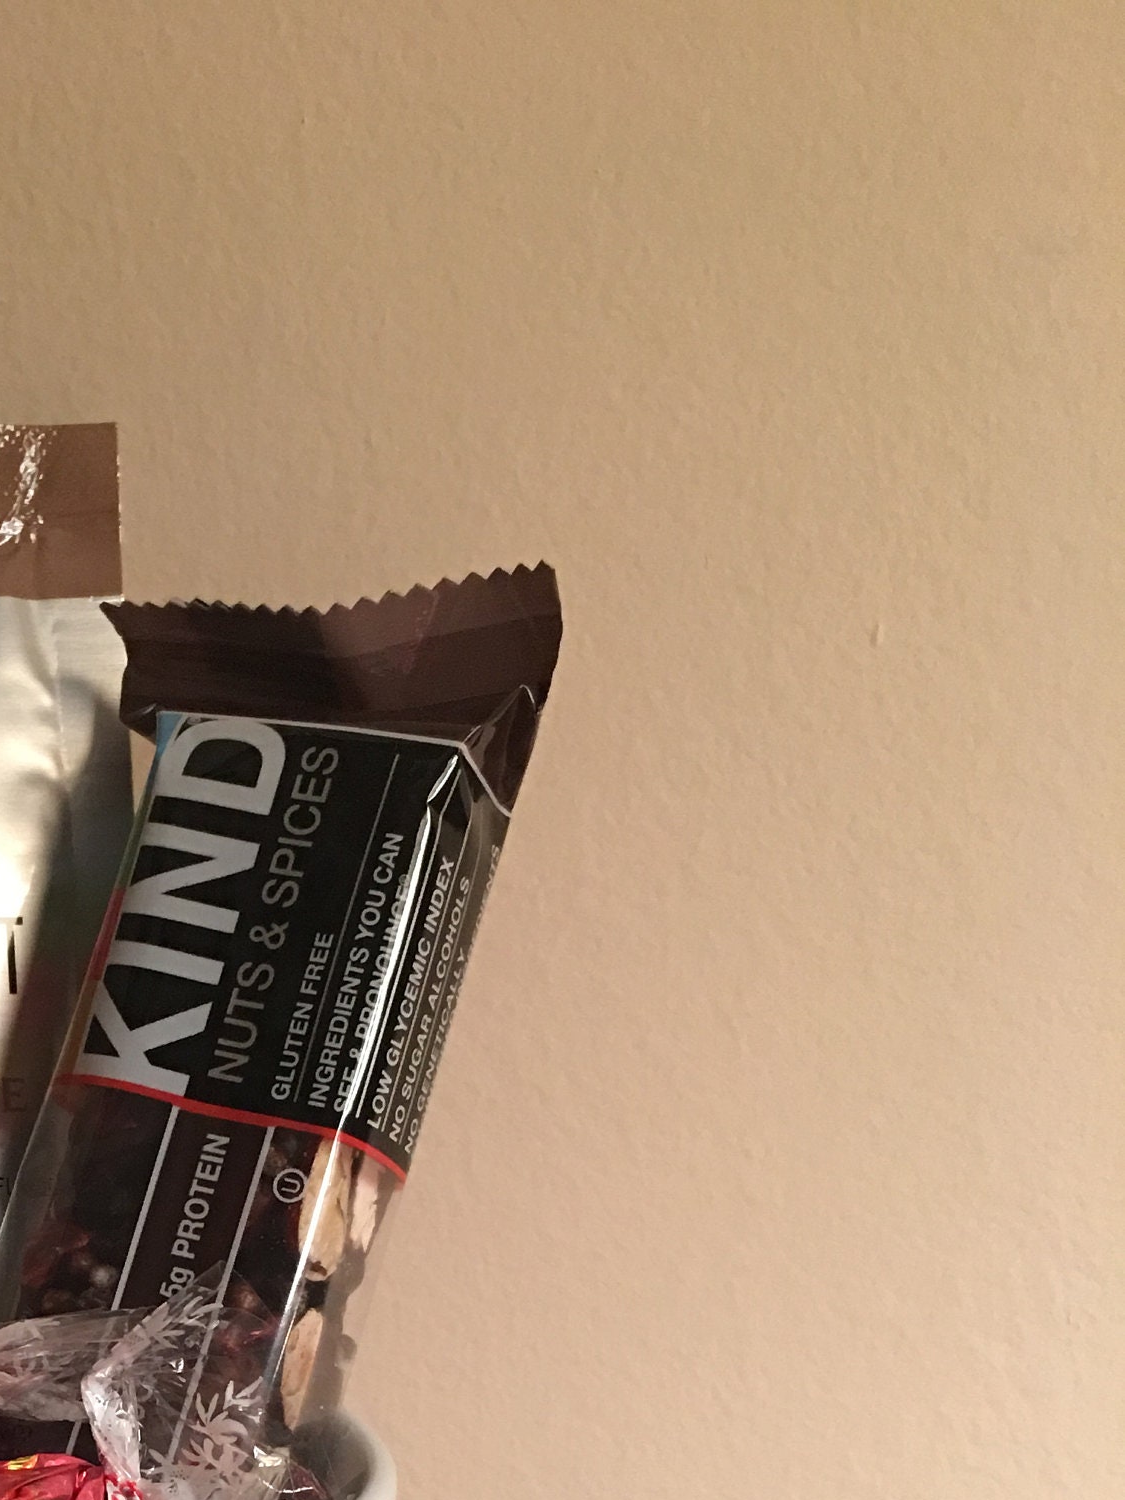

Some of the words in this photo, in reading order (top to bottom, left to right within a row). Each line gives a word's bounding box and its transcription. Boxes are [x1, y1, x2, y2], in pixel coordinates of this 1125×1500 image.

[82, 717, 286, 1098] KIND
[262, 745, 339, 909] SPICES
[249, 921, 290, 951] &
[271, 1002, 311, 1101] GLUTEN
[300, 932, 335, 994] FREE
[308, 946, 370, 1108] INGREDIENTS
[354, 889, 387, 940] YOU
[373, 832, 404, 884] CAN
[367, 1070, 393, 1130] LOW
[386, 937, 431, 1067] GLYCEMIC
[424, 855, 455, 934] INDEX
[389, 1104, 406, 1143] NO
[401, 1014, 432, 1100] SUGAR
[428, 876, 470, 1011] ALCOHOLS
[208, 961, 276, 1084] NUTS
[171, 1133, 231, 1260] PROTEIN
[404, 1118, 419, 1155] NO
